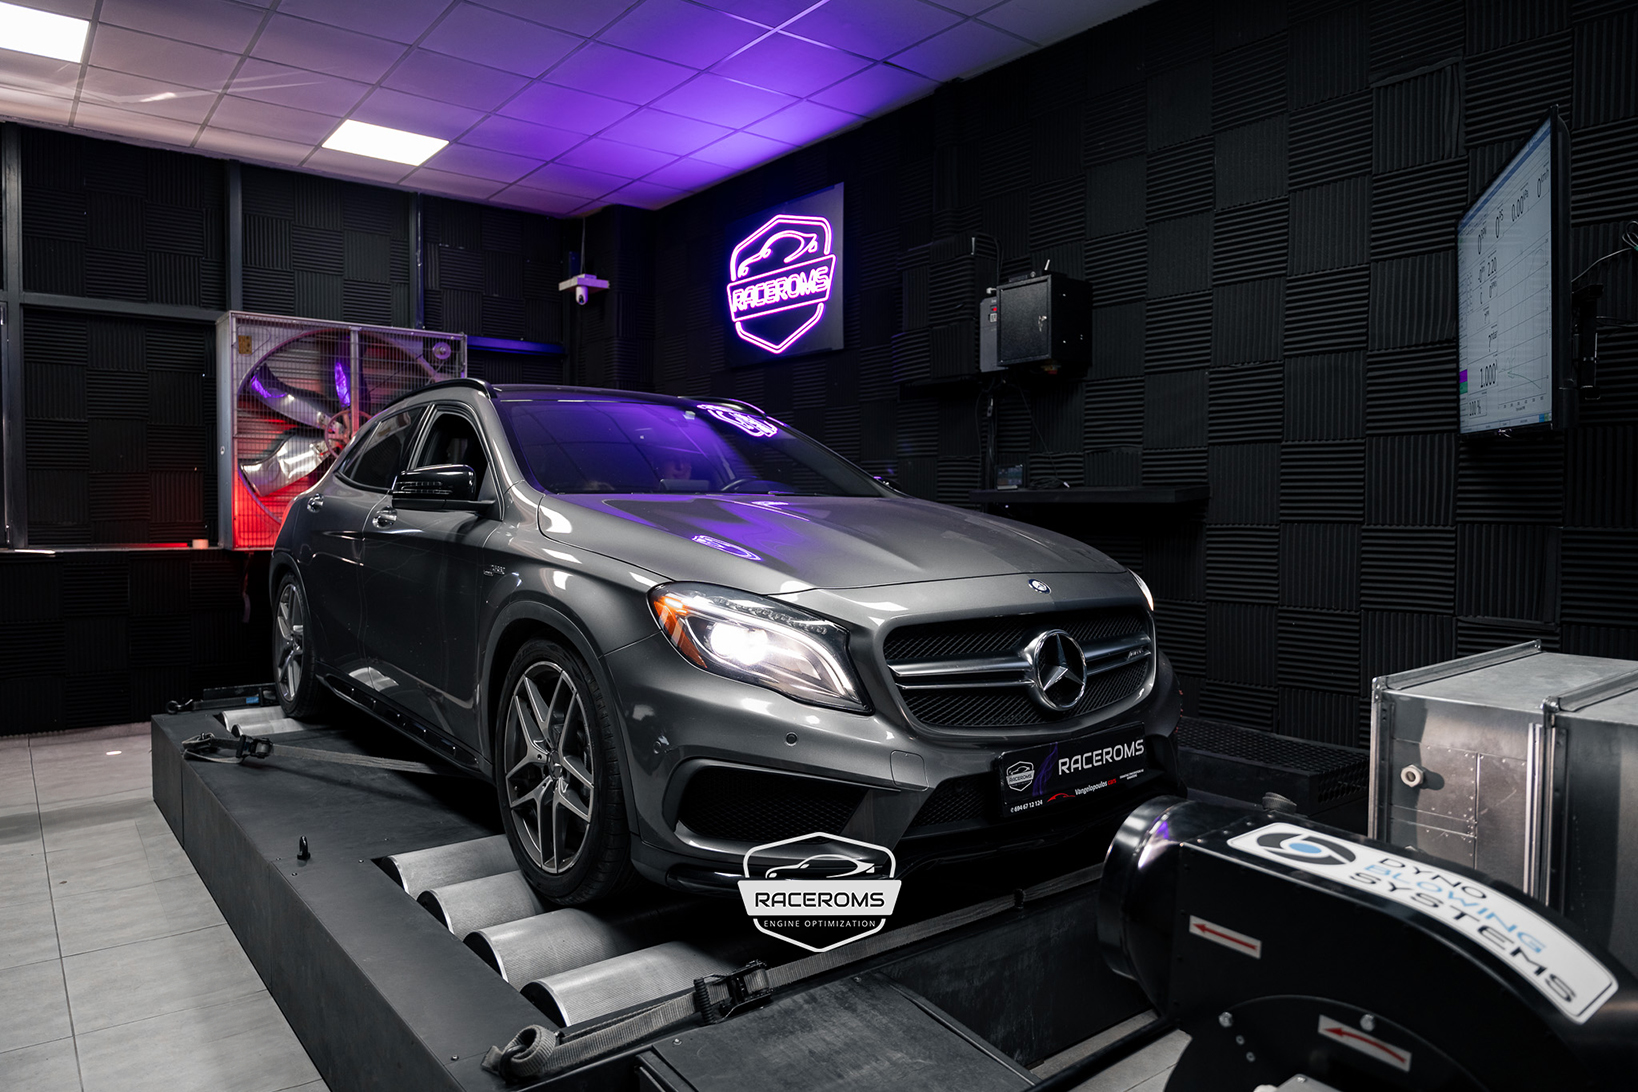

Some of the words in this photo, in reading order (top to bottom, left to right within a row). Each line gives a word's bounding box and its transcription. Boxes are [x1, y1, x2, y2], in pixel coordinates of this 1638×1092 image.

[732, 265, 829, 312] RACEROMS
[1058, 739, 1145, 776] RACEROMS
[1378, 857, 1487, 899] DYNO
[1364, 864, 1547, 954] BLOWING
[1350, 871, 1577, 1003] SYSTEMS
